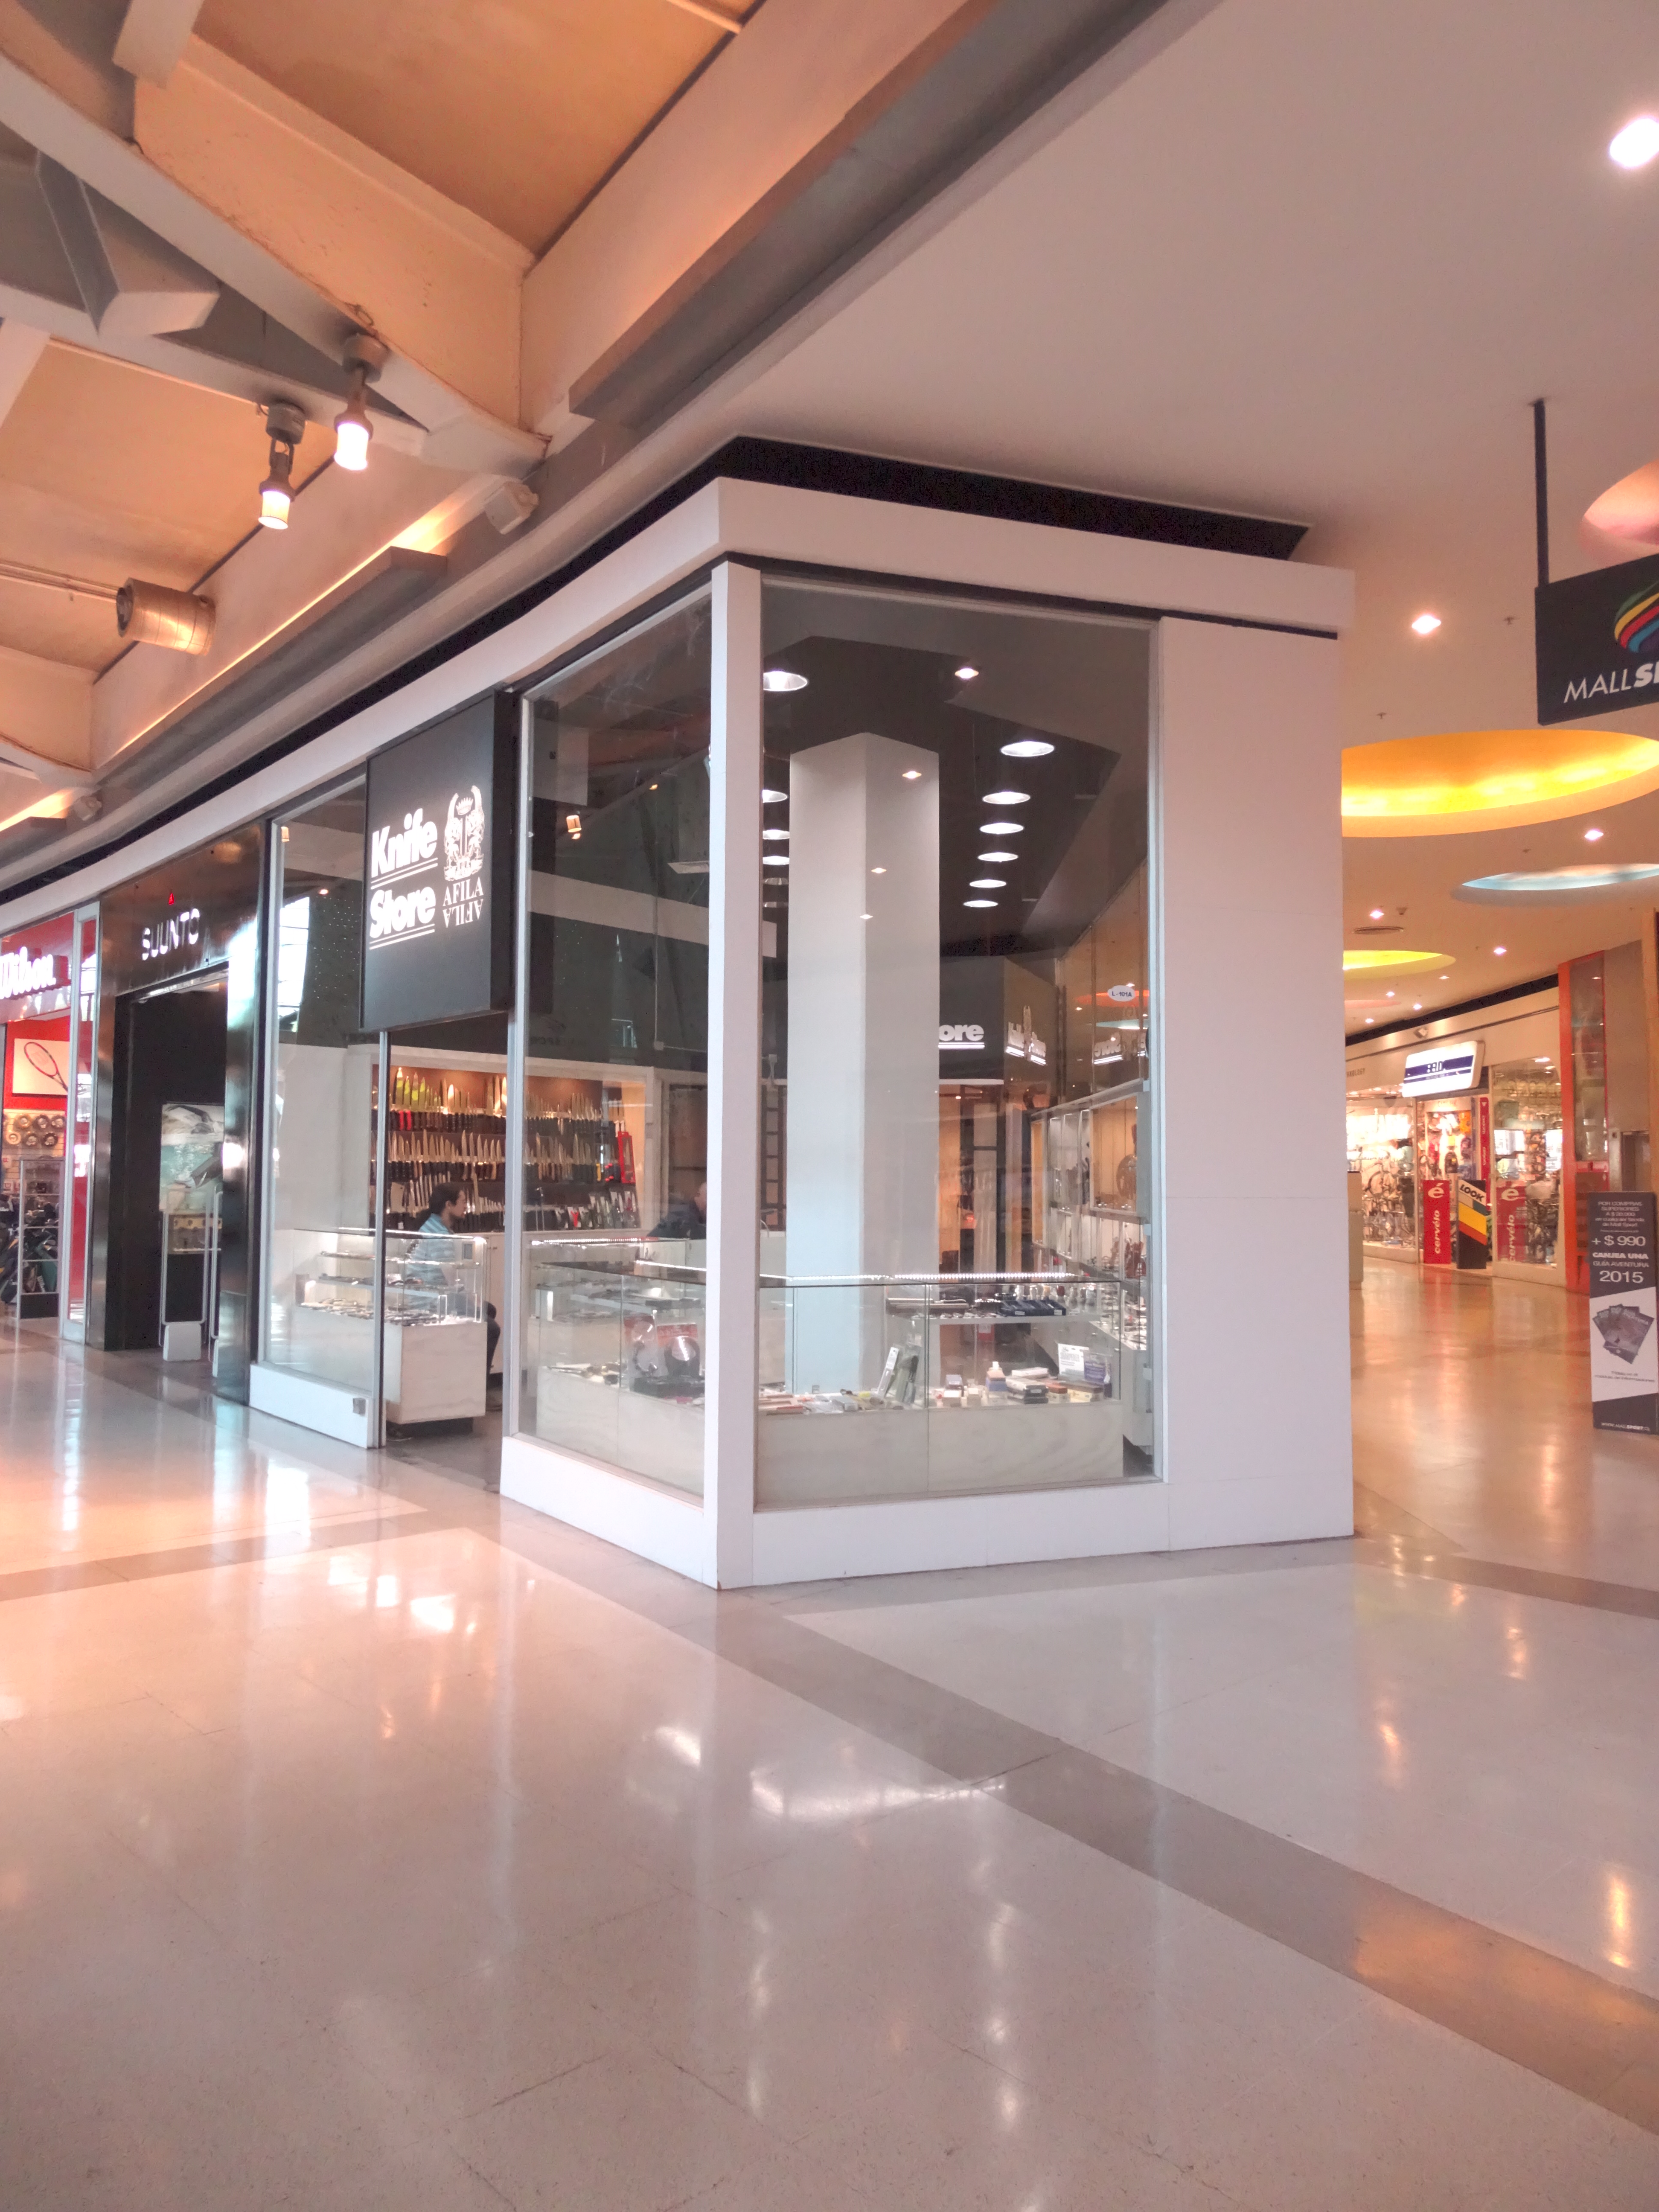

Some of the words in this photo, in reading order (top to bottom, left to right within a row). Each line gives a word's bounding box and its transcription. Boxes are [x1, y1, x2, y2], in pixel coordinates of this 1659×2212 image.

[371, 808, 438, 878] Knife
[442, 876, 484, 907] AFILA
[370, 887, 436, 938] Store
[142, 908, 200, 960] SUUNTO
[939, 1025, 984, 1041] ore
[1459, 1184, 1485, 1202] LOOK
[1432, 1210, 1441, 1254] cervélo
[1604, 1234, 1615, 1247] $
[1617, 1236, 1646, 1246] 990
[1599, 1270, 1644, 1284] 2015
